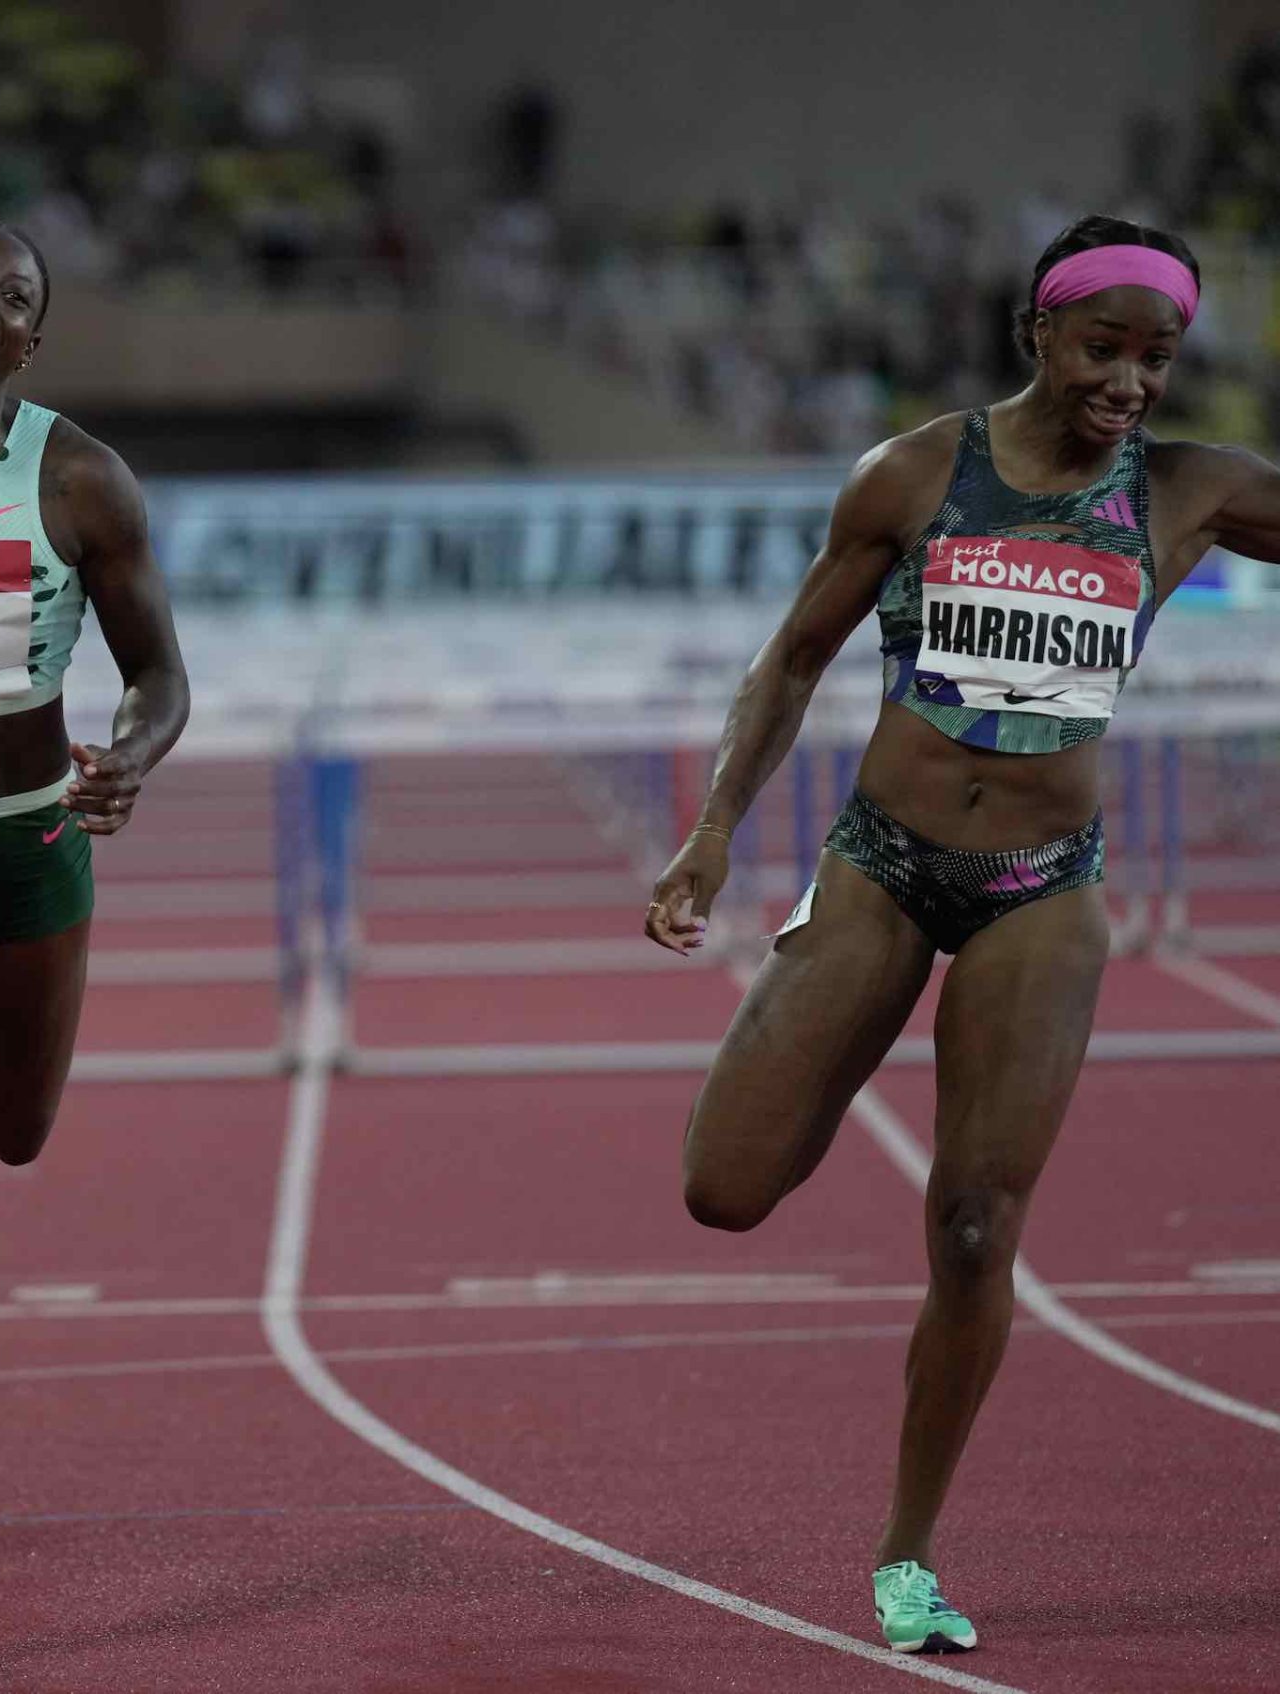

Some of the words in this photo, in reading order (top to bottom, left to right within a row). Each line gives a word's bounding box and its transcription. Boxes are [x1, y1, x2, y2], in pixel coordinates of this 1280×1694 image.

[953, 539, 1008, 559] visit
[950, 559, 1106, 599] MONACO
[928, 601, 1126, 669] HARRISON
